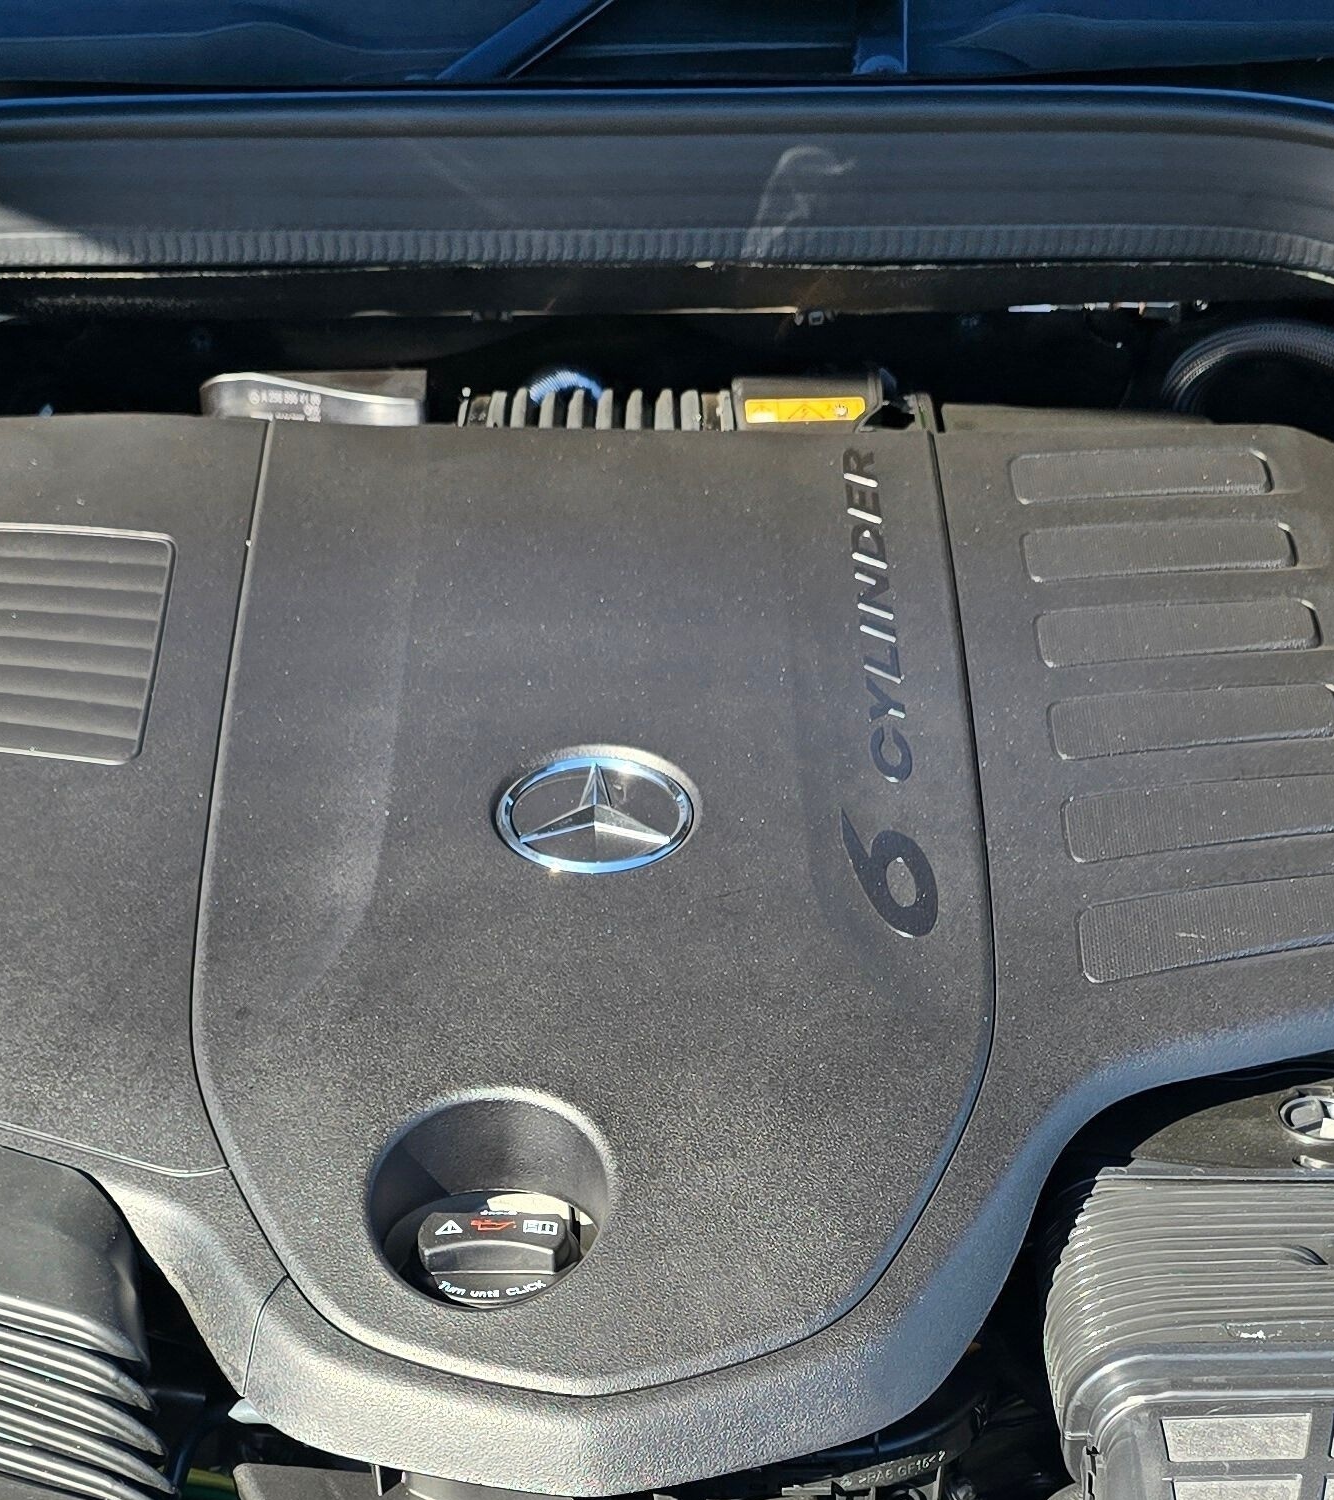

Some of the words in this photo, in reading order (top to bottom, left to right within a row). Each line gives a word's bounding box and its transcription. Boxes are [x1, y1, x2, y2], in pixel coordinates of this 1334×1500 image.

[842, 446, 913, 784] CYLINDER
[840, 807, 939, 939] 6
[438, 1280, 466, 1296] Turn
[470, 1289, 500, 1298] until
[505, 1279, 547, 1296] CLICK
